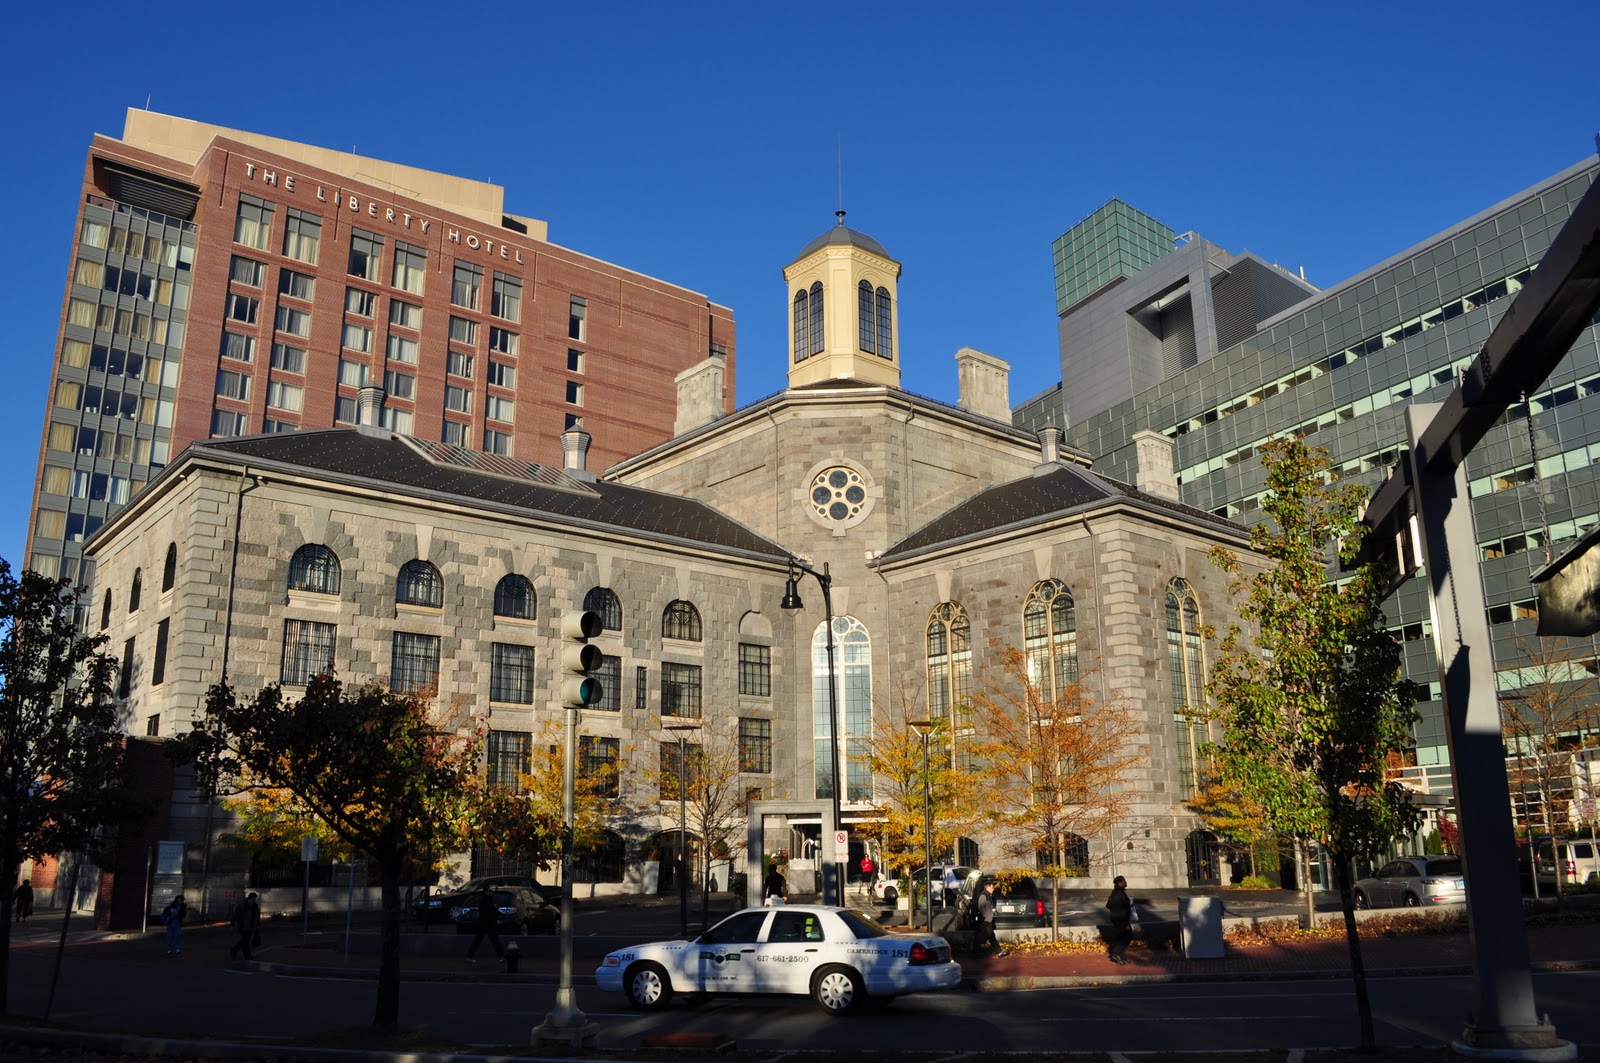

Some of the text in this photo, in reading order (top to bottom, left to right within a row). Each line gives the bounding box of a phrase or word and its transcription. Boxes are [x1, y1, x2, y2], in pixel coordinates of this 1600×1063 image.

[246, 162, 524, 265] THE LIBERTY HOTEL
[621, 953, 635, 961] 181
[892, 949, 909, 958] 181
[757, 954, 809, 963] 617-661-2500
